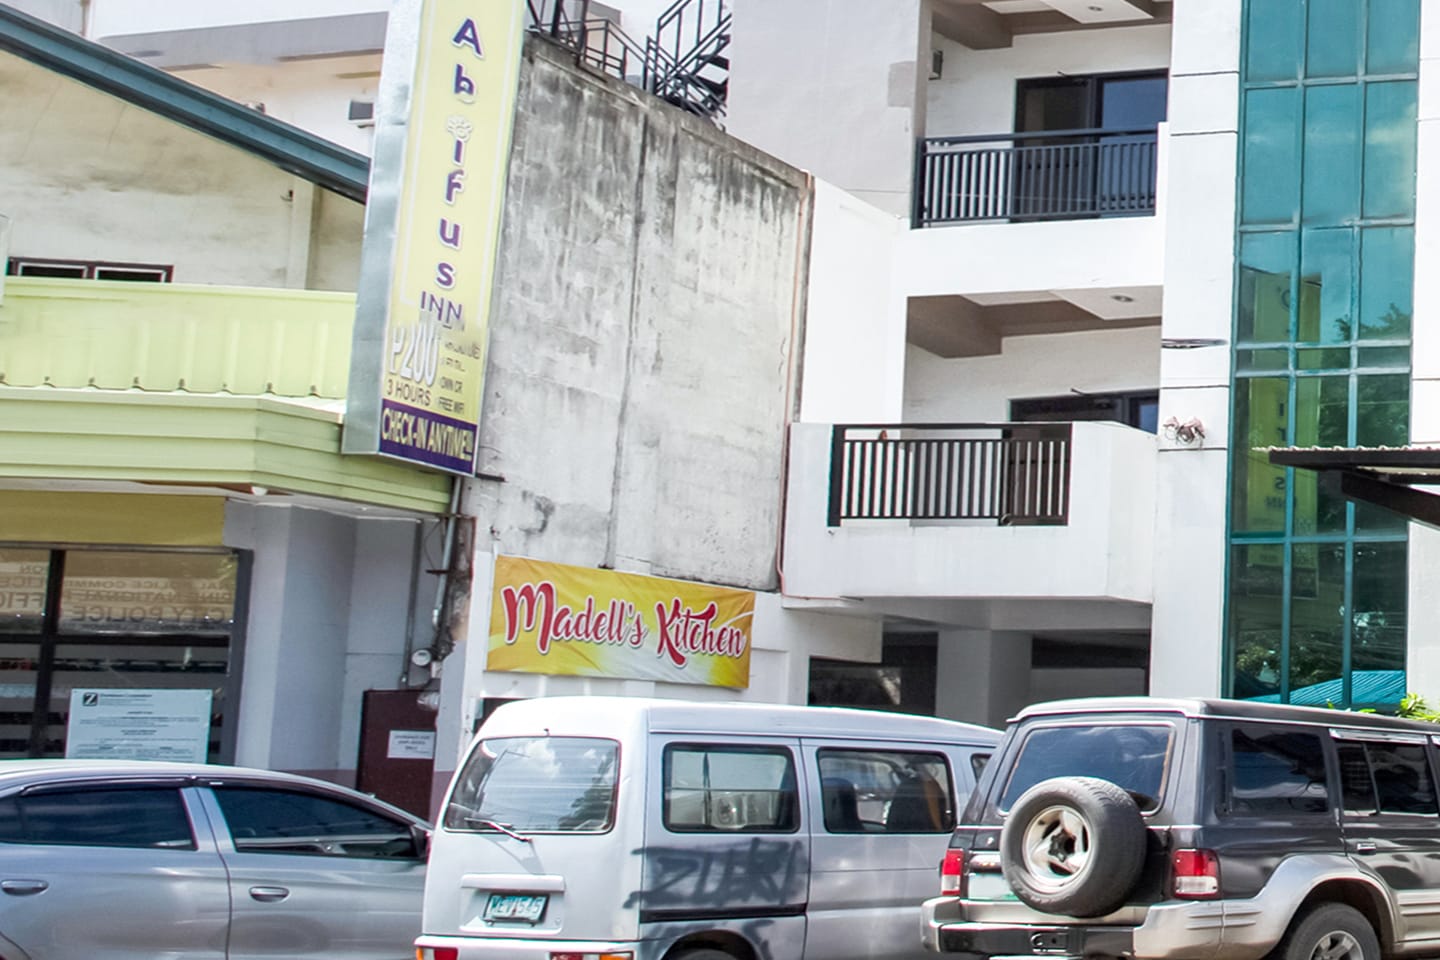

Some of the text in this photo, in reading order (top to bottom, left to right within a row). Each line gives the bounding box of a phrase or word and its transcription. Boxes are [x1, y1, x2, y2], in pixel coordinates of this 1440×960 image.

[386, 379, 431, 406] 3 HOURS
[382, 407, 429, 451] CHECK-IN
[502, 581, 746, 666] Madell's Kitchen
